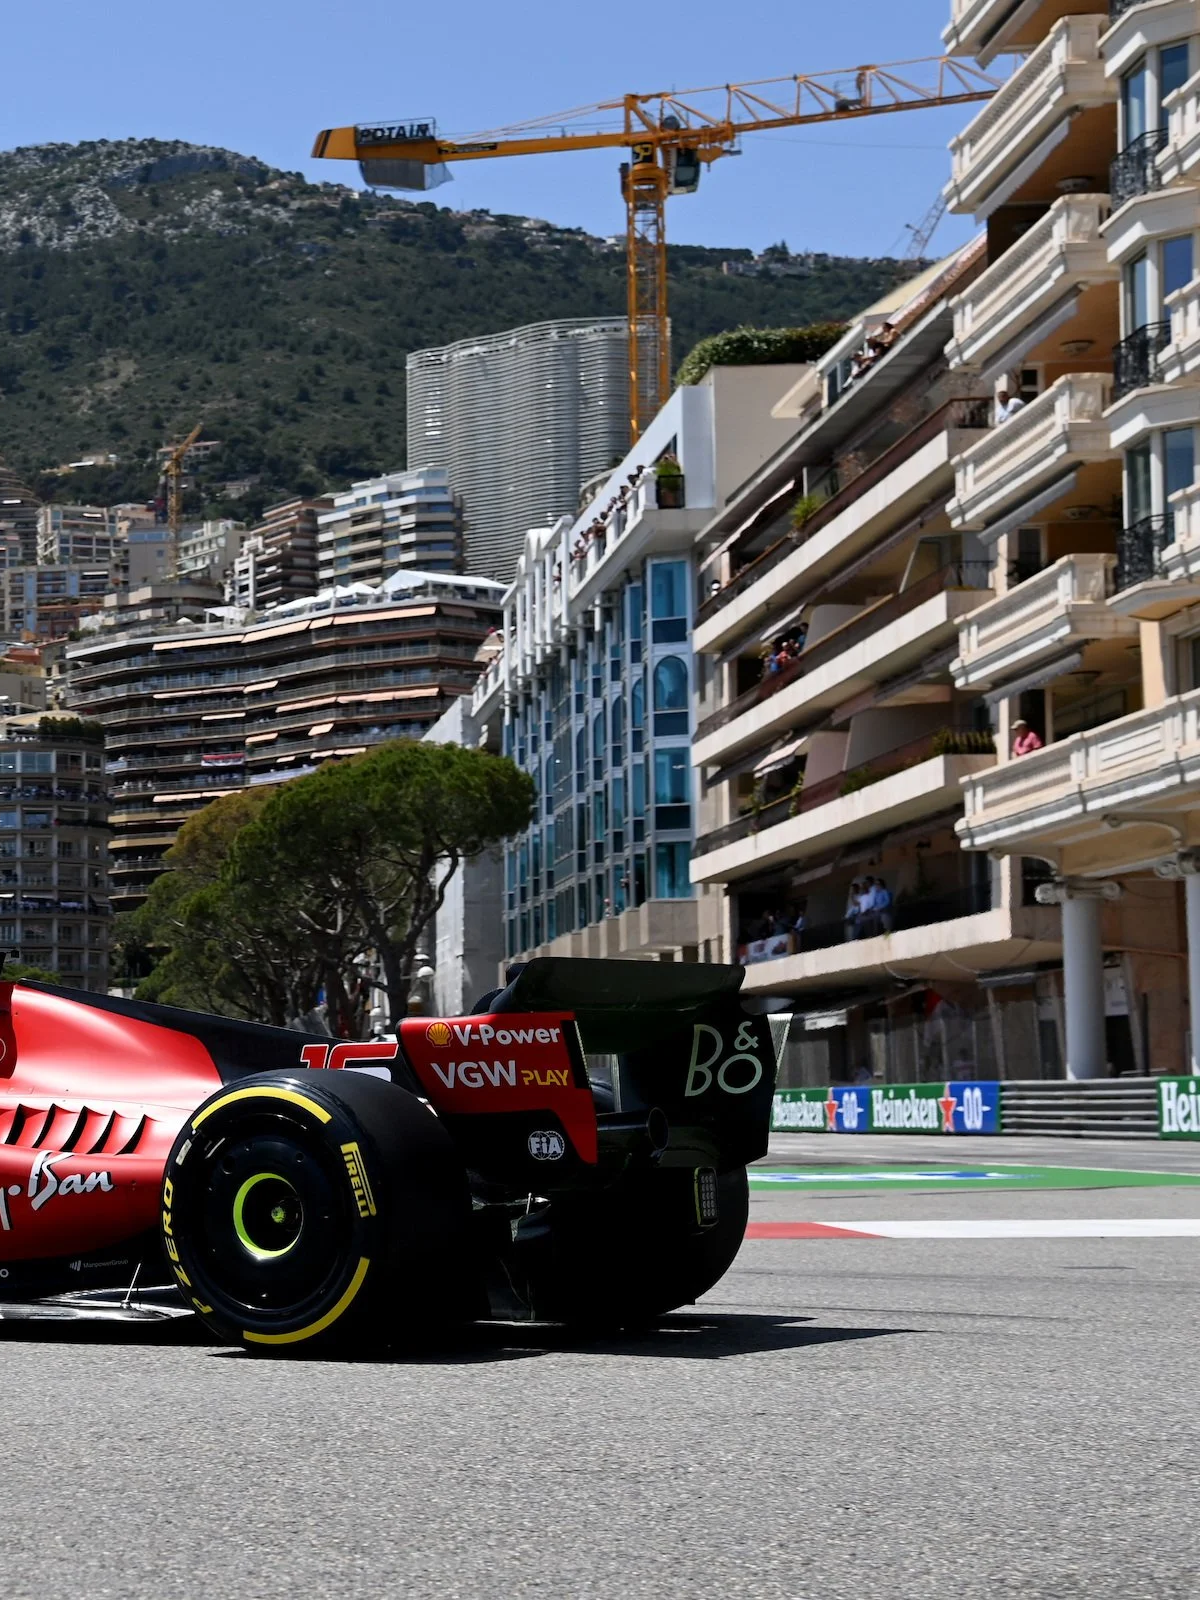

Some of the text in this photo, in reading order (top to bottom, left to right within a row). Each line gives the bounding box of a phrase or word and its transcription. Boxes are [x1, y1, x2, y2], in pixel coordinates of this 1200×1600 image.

[361, 123, 430, 142] POTAIN
[453, 1024, 560, 1046] V-Power
[431, 1059, 569, 1089] VGW PLAY
[871, 1089, 939, 1129] Heineken
[340, 1141, 377, 1218] PIRELLI
[162, 1176, 192, 1288] ZERO
[192, 1297, 214, 1314] P
